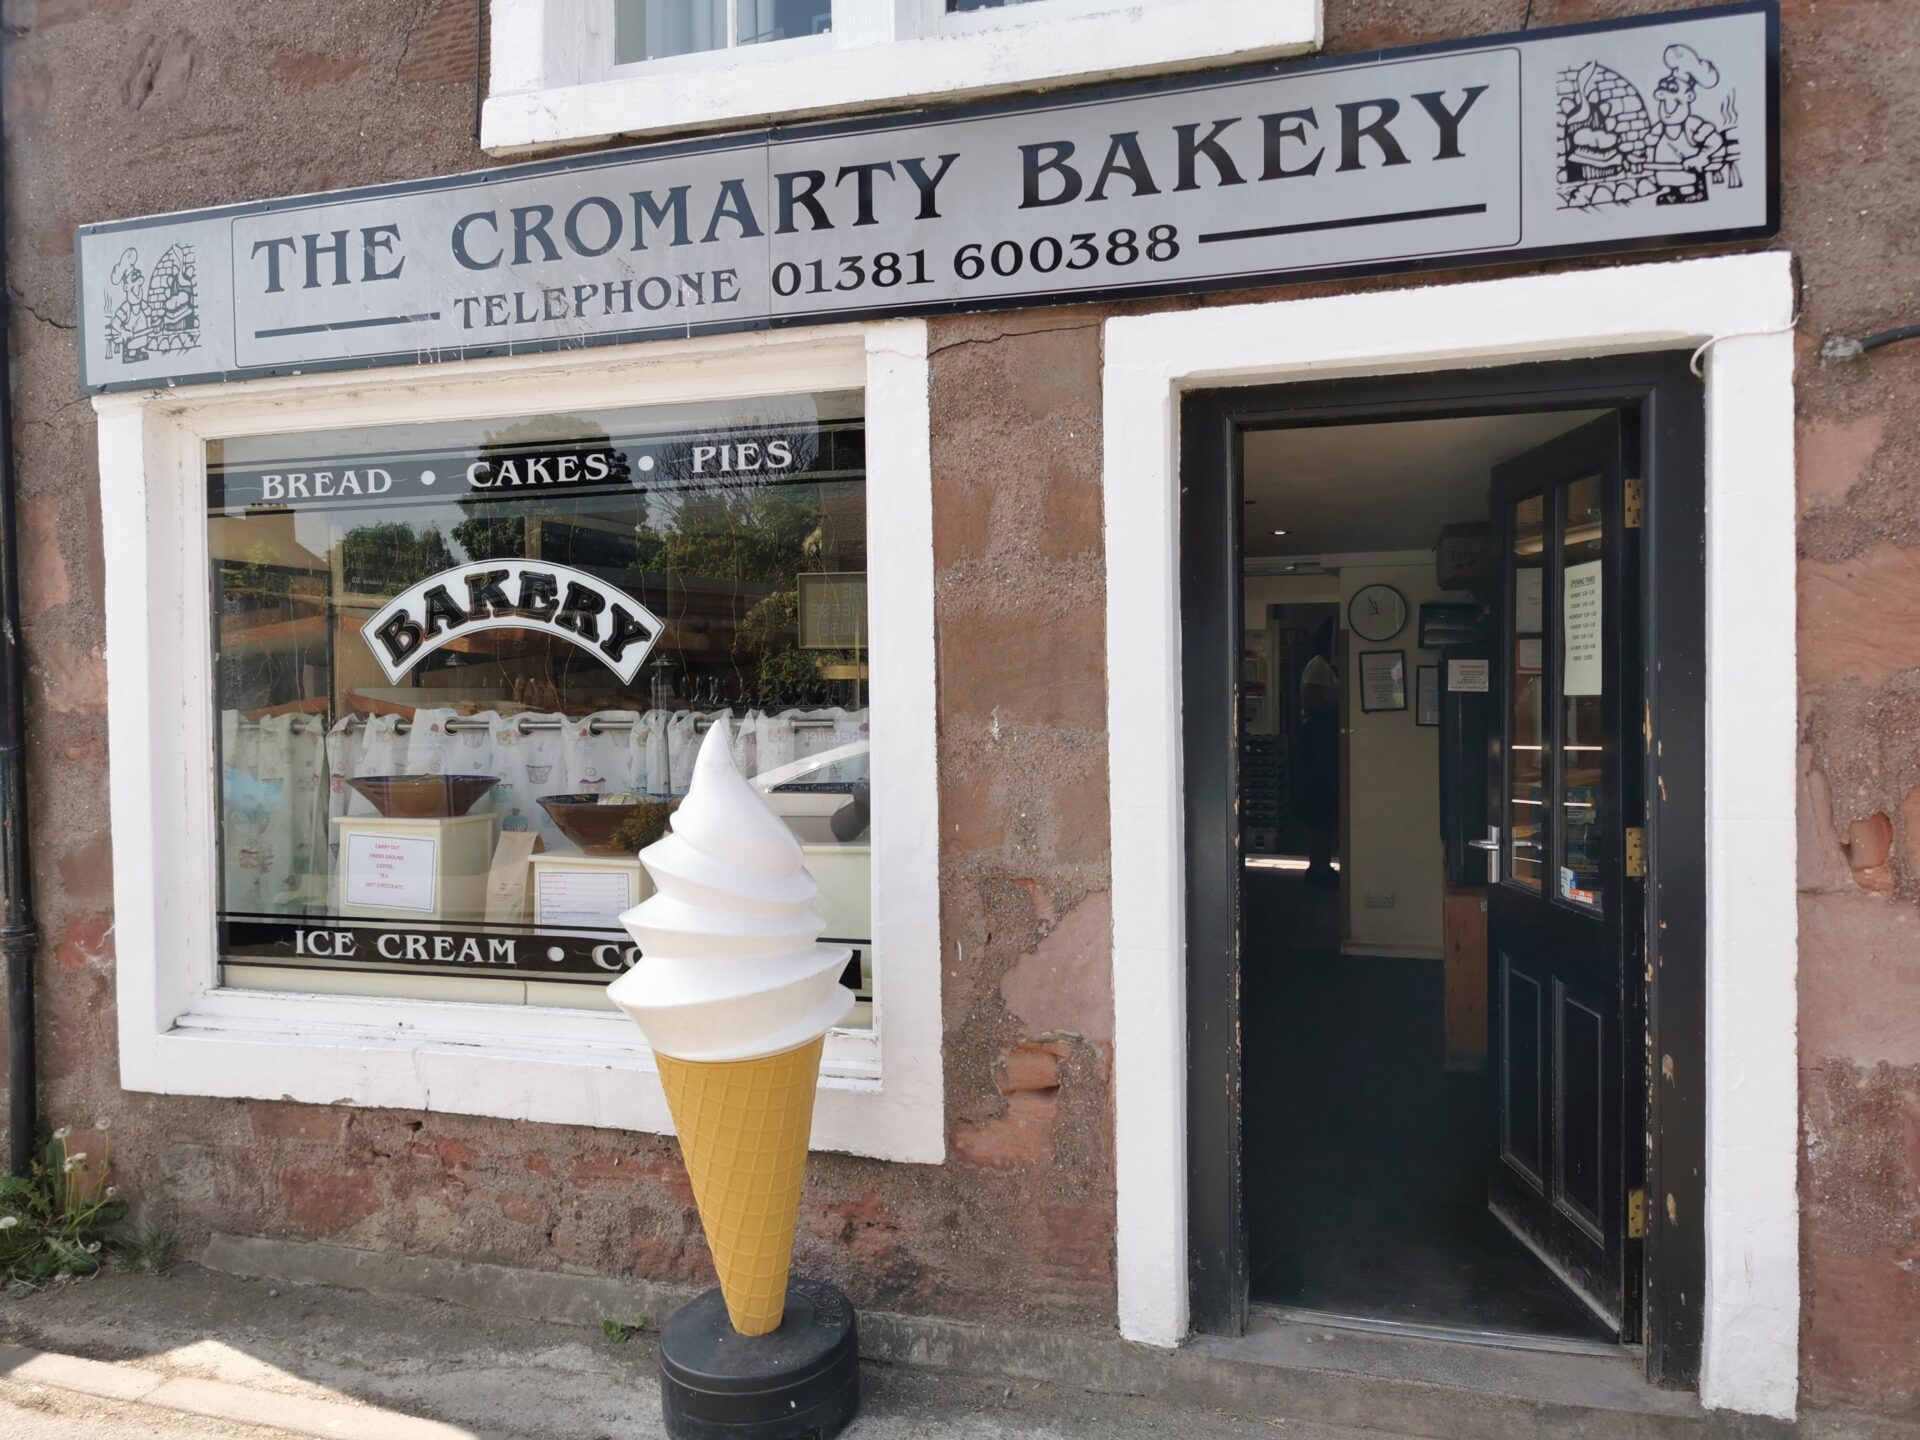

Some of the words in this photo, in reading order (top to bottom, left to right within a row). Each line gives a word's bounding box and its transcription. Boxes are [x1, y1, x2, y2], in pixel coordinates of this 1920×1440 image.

[250, 223, 406, 294] THE
[451, 152, 961, 271] CROMARTY
[1017, 85, 1491, 210] BAKERY
[454, 267, 742, 330] TELEPHONE
[771, 250, 936, 297] 01381
[953, 223, 1181, 280] 600388
[261, 467, 393, 500] BREAD
[466, 452, 610, 489] CAKES
[690, 440, 794, 474] PIES
[374, 568, 653, 668] BAKERY
[295, 929, 357, 958] ICE
[376, 932, 517, 965] CREAM
